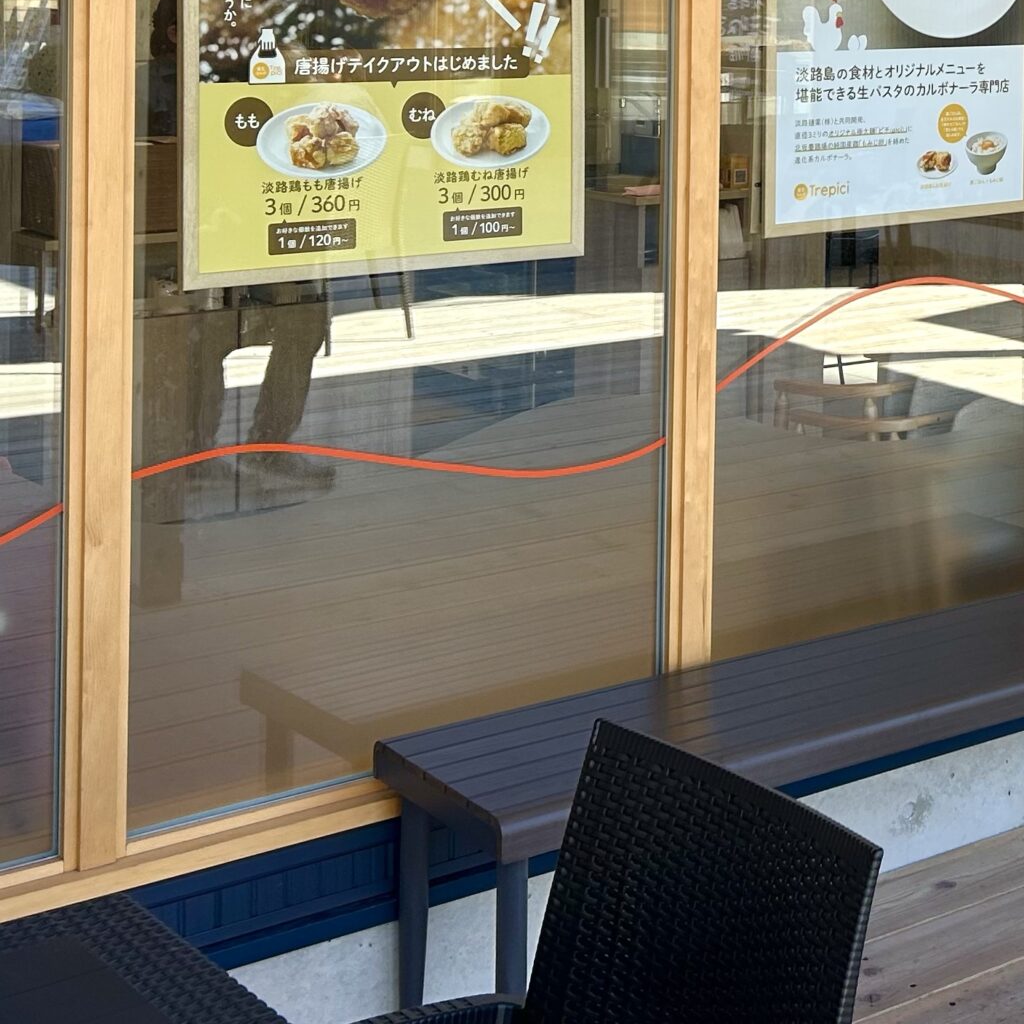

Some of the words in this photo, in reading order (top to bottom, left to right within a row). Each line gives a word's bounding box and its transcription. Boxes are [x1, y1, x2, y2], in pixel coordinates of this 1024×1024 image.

[293, 54, 518, 76] 唐揚げテイクアウトはじめました
[795, 62, 986, 83] 淡路島の食材とオリジナルメニューを
[795, 79, 1010, 103] 堪能できる生パスタのカルボナーラ専門店
[234, 113, 260, 129] もも
[408, 107, 436, 123] むね
[434, 167, 529, 184] 淡路鶏むね唐揚げ
[262, 176, 363, 194] 淡路鶏もも唐揚げ
[809, 180, 851, 197] Trepici
